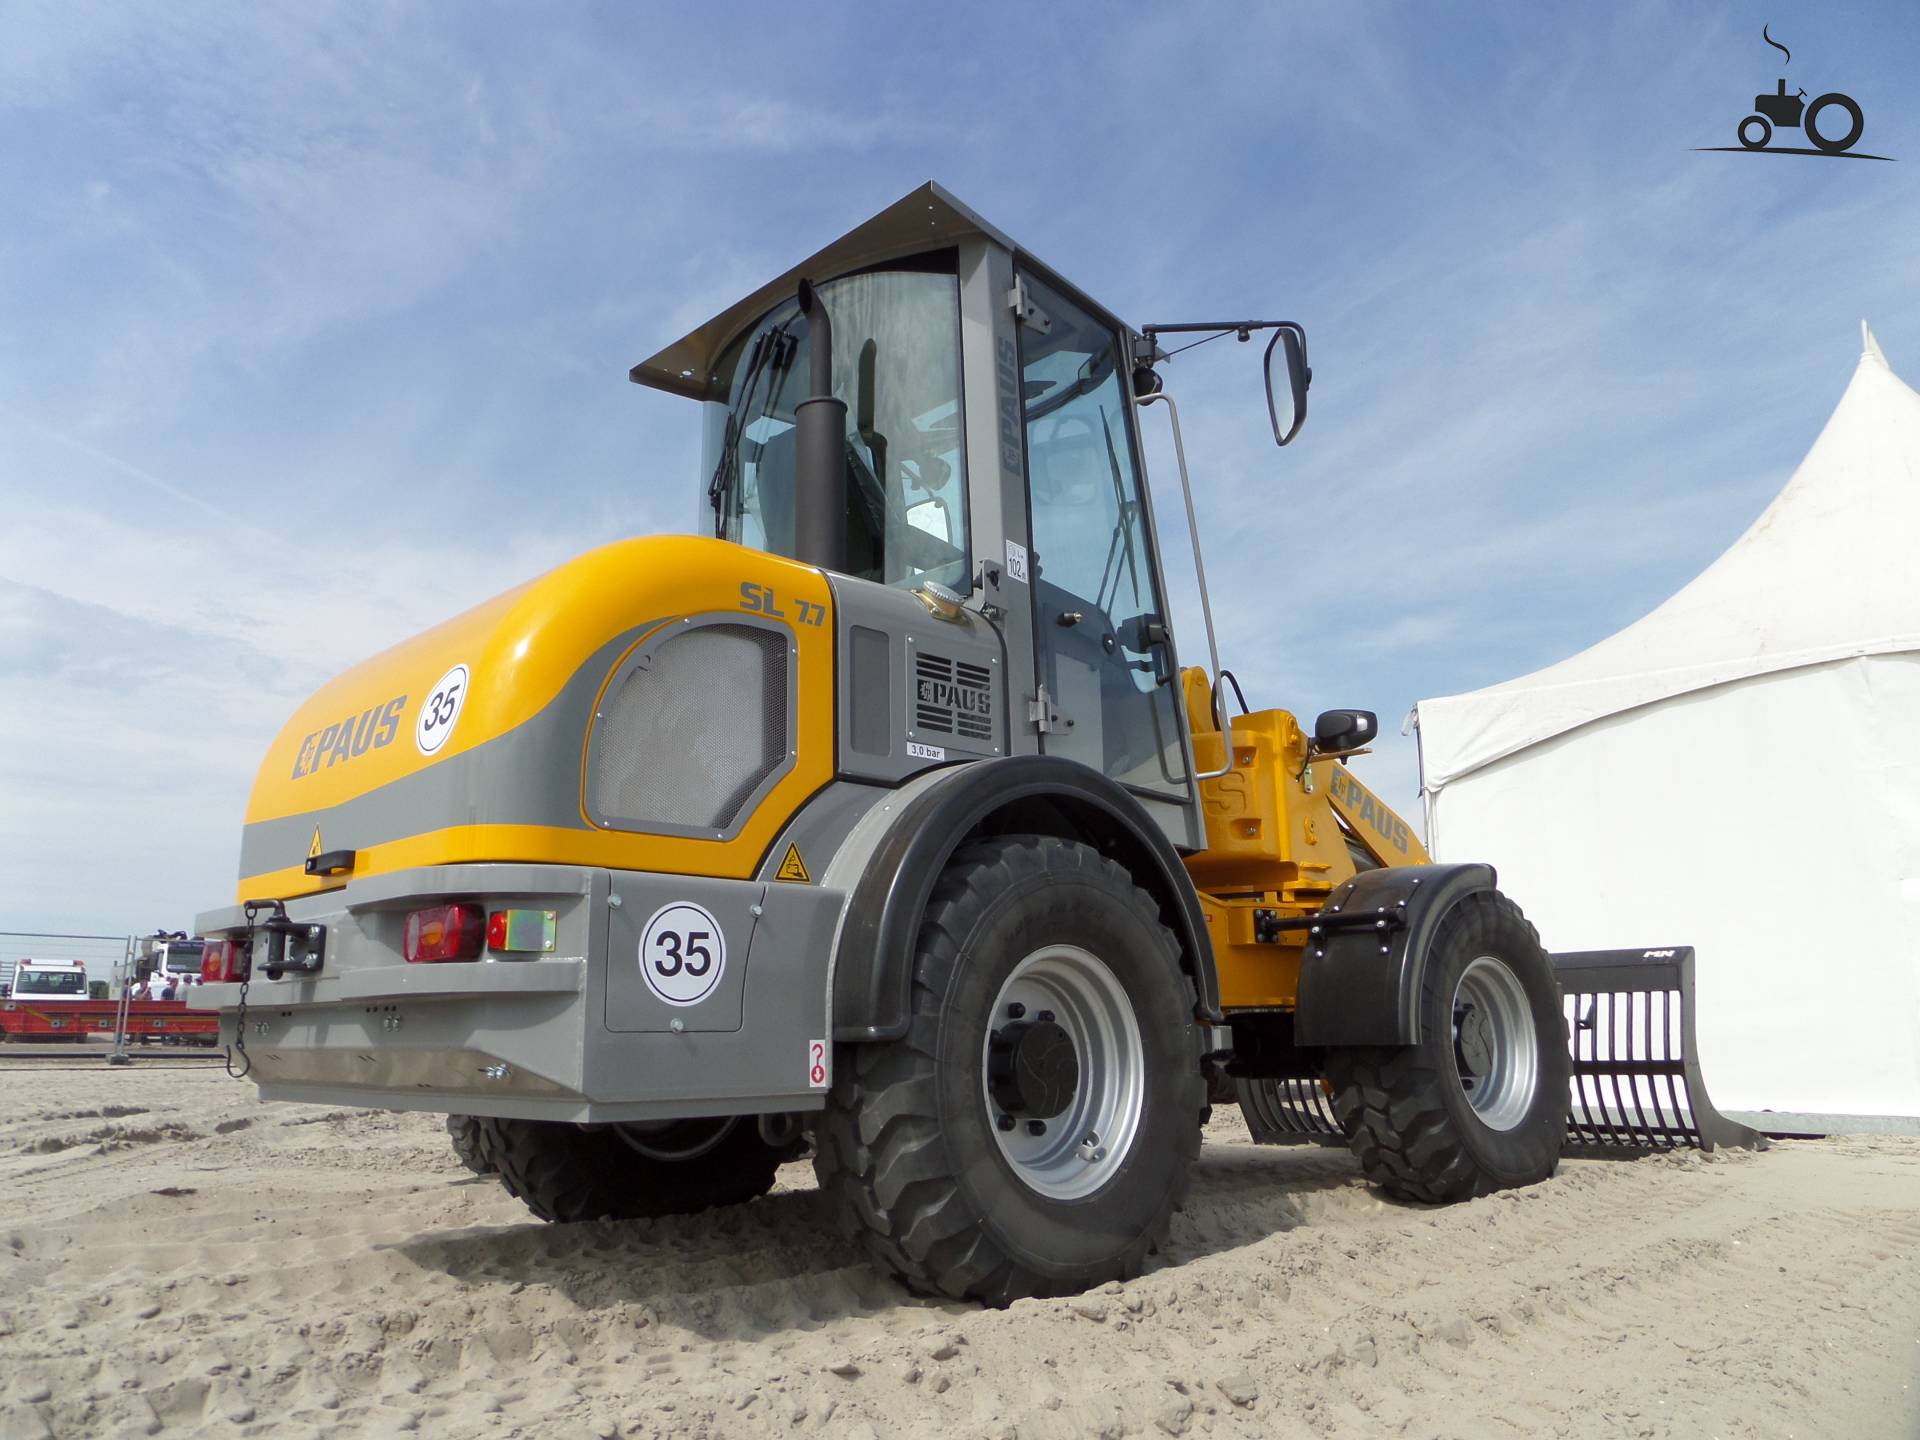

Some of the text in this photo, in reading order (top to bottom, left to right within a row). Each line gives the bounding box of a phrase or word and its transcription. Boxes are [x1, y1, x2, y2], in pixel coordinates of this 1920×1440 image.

[998, 335, 1019, 449] PAUS
[1008, 558, 1022, 578] 102
[740, 581, 826, 627] SL 7.7
[423, 683, 461, 732] 35
[933, 682, 991, 715] PAUS
[310, 694, 408, 774] PAUS
[911, 744, 941, 759] 3,0 bar
[1345, 779, 1409, 855] PAUS
[654, 930, 712, 977] 35
